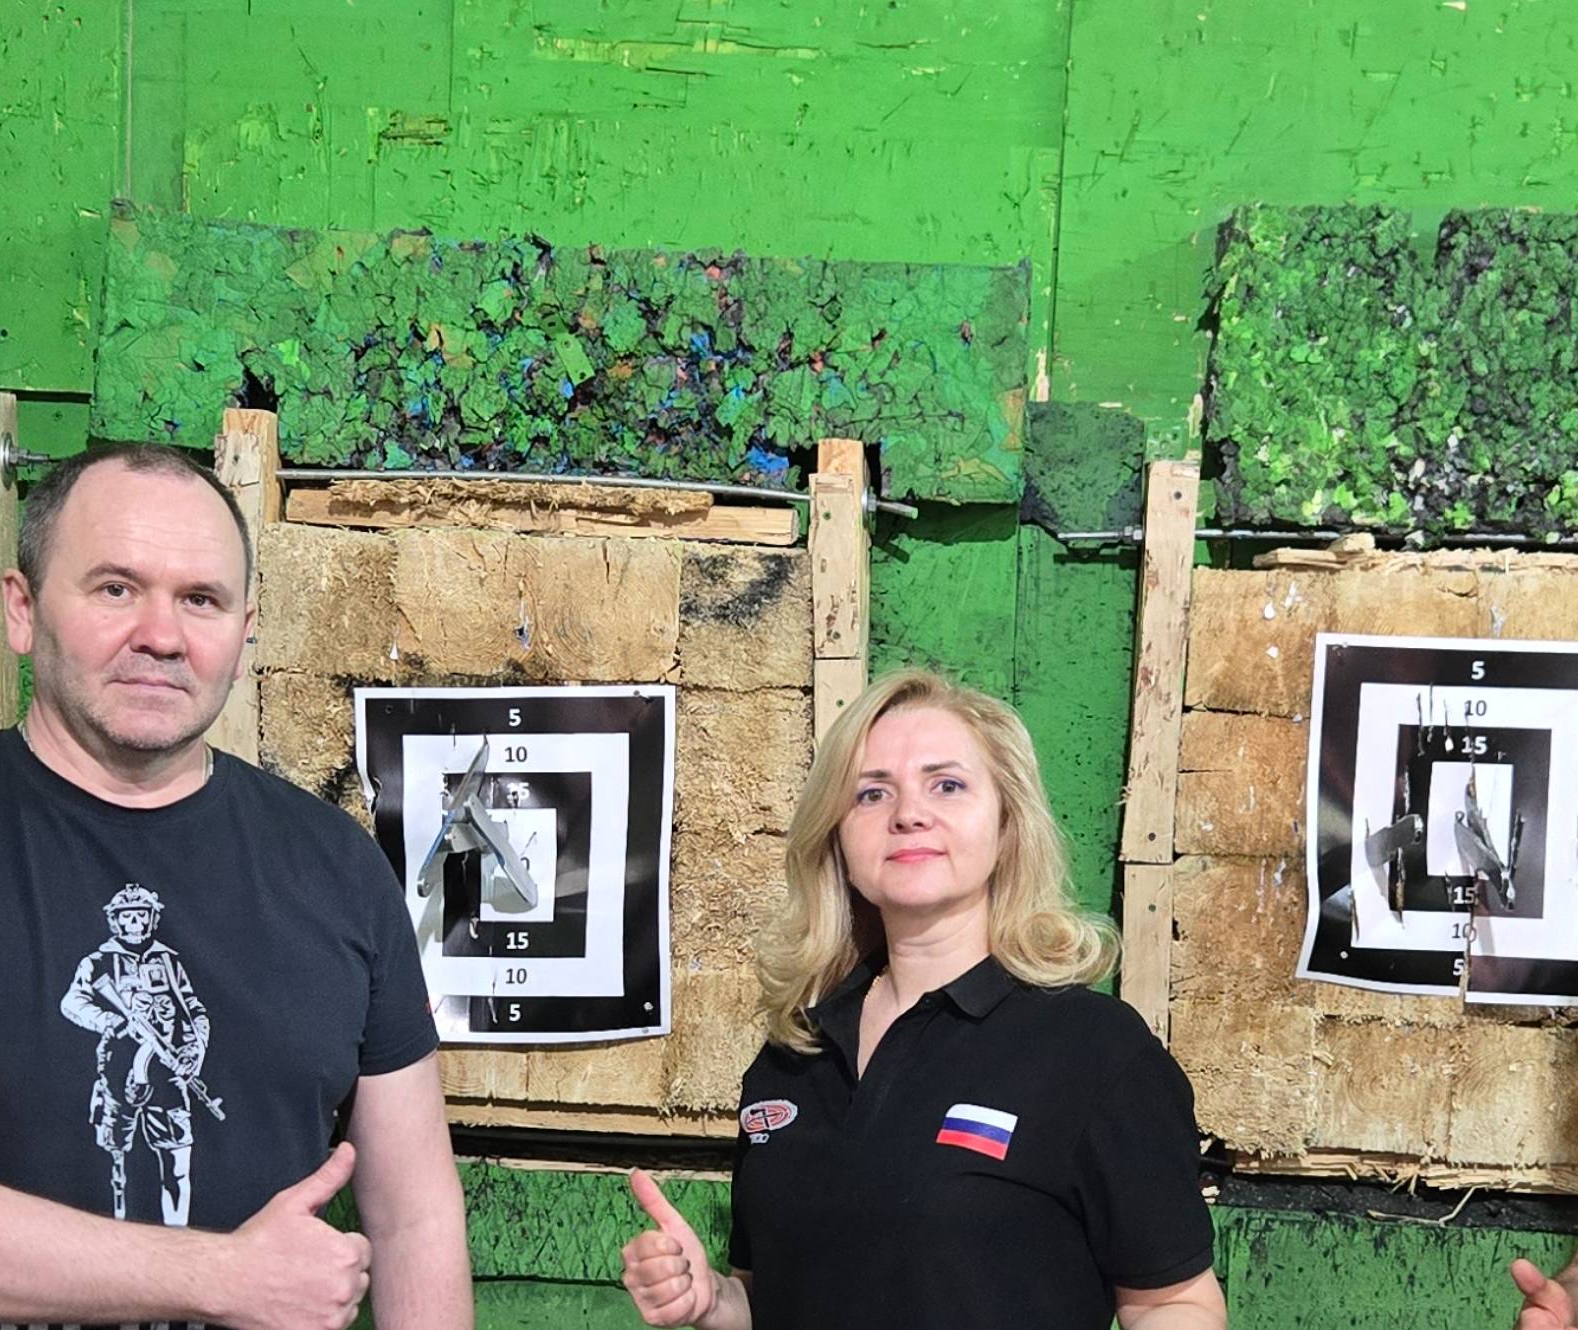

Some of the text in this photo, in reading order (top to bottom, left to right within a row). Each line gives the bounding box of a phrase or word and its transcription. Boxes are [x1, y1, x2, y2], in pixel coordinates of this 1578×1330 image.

[1471, 660, 1486, 680] 5
[508, 708, 522, 727] 5
[1464, 699, 1488, 717] 10
[504, 746, 528, 763] 10
[1461, 735, 1488, 755] 15
[1453, 886, 1478, 905] 15
[506, 931, 530, 950] 15
[1452, 923, 1477, 943] 10
[505, 967, 528, 985] 10
[1452, 957, 1465, 976] 5
[508, 1003, 521, 1022] 5
